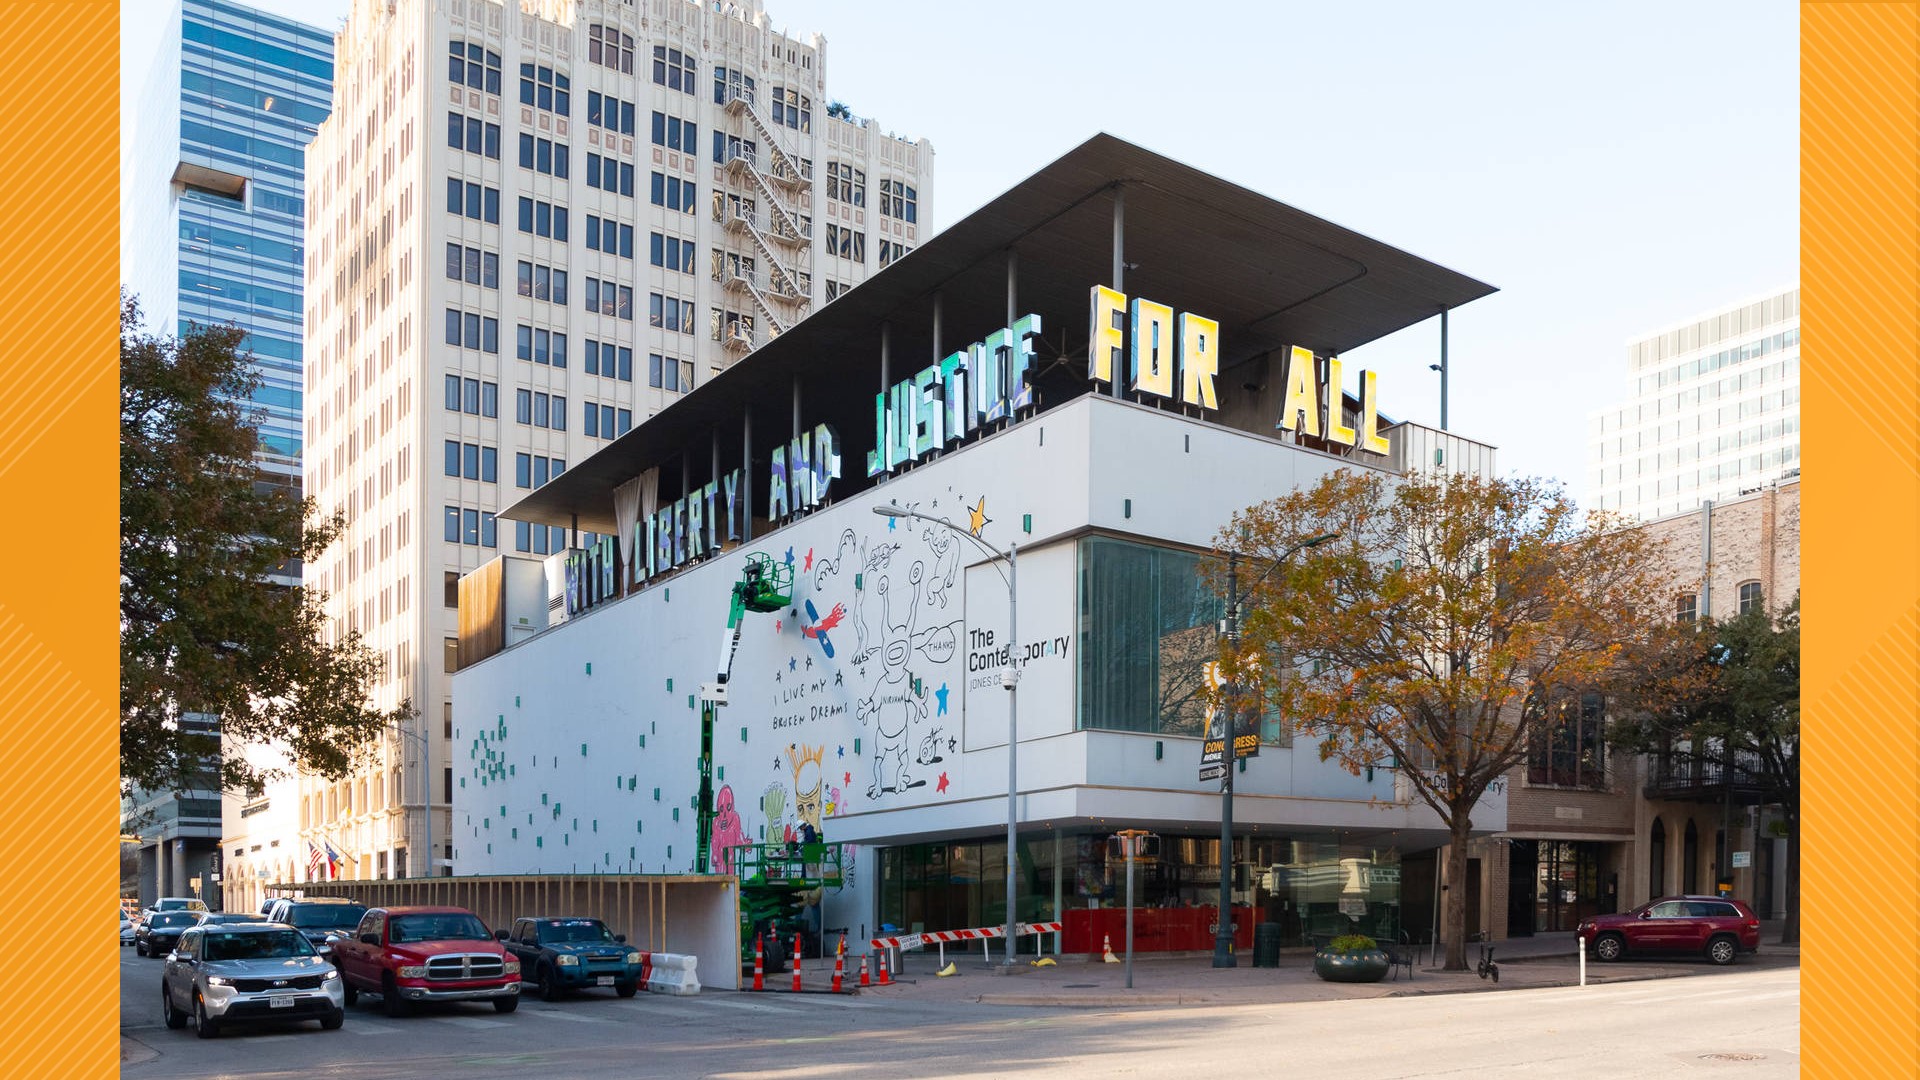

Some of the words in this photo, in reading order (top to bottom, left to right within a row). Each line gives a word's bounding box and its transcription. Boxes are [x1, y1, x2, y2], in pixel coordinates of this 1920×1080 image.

[1088, 284, 1219, 411] FOR
[1276, 345, 1390, 456] ALL
[564, 535, 619, 616] WITH
[634, 468, 742, 584] LIBERTY
[768, 422, 842, 522] AND
[866, 313, 1042, 478] JUSTICE
[969, 628, 994, 650] The
[969, 635, 1070, 672] ConteporAry
[783, 683, 805, 704] LIVE
[811, 678, 827, 693] MY
[969, 676, 992, 692] JONES
[810, 701, 848, 722] DREAMS
